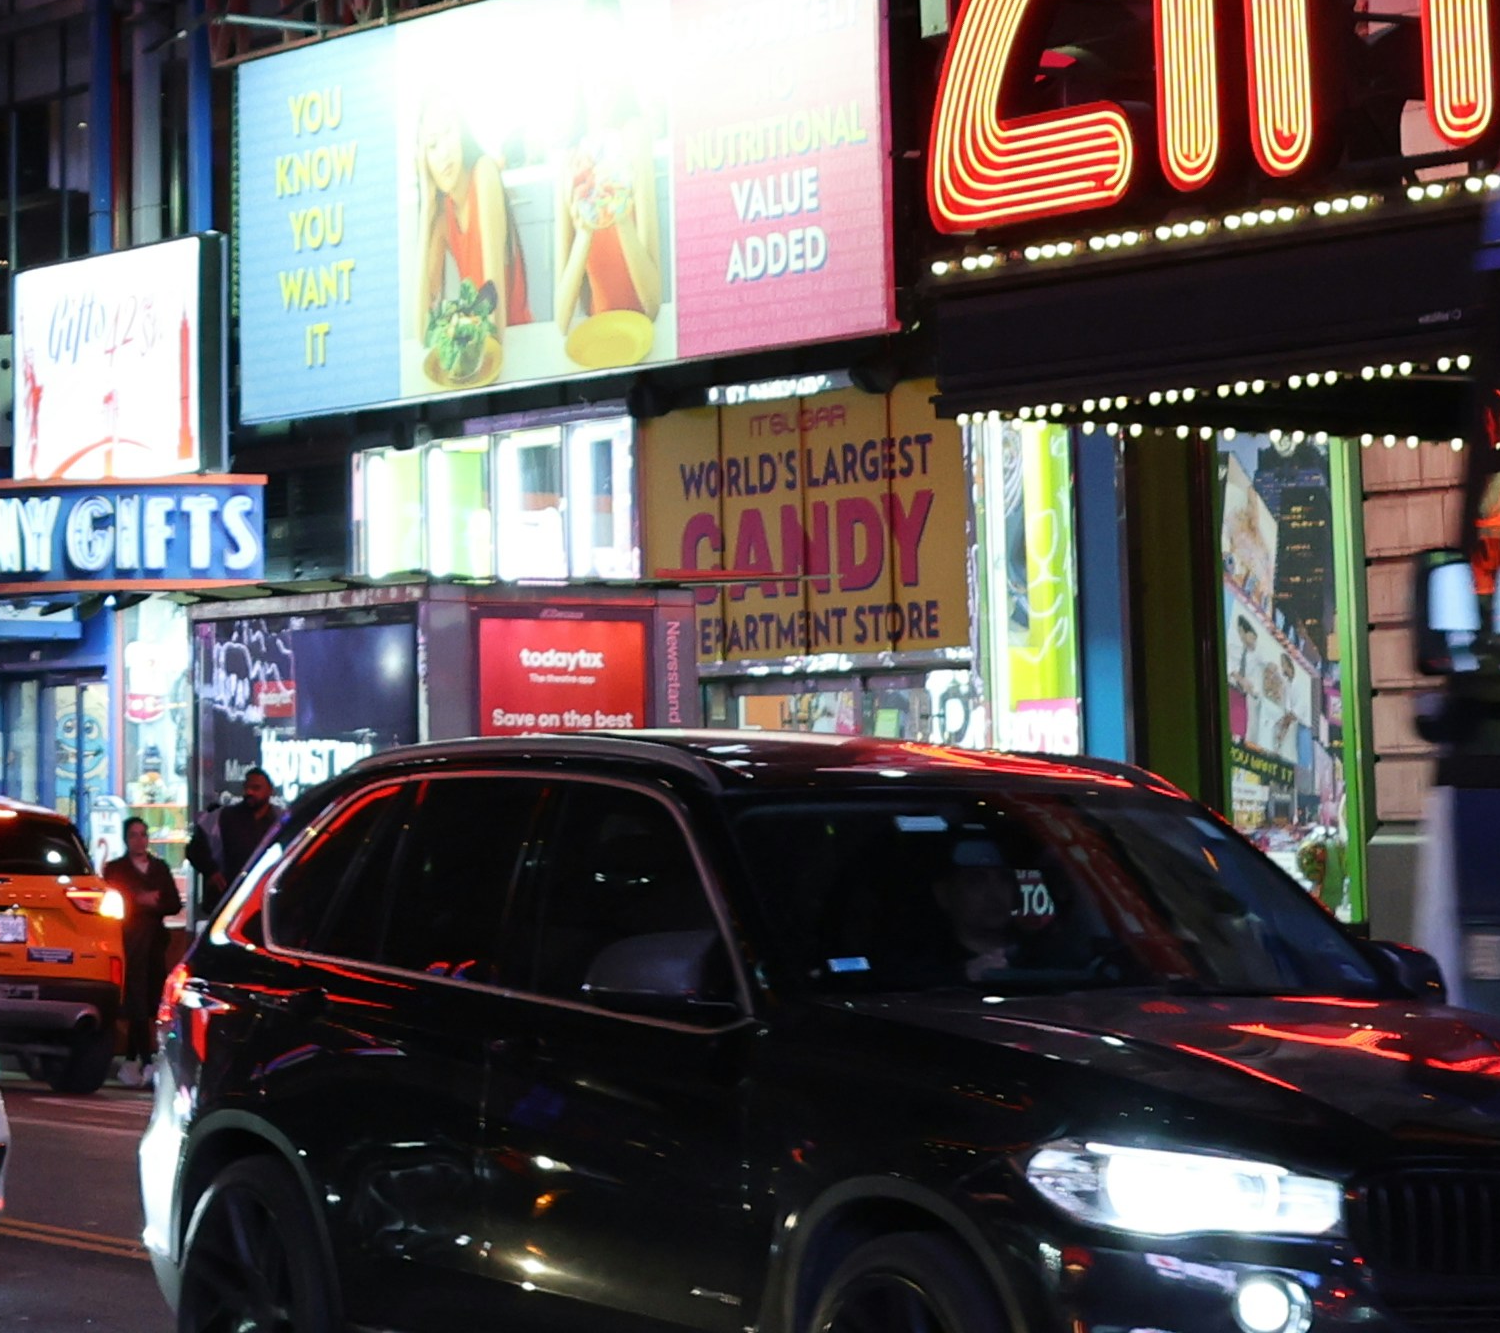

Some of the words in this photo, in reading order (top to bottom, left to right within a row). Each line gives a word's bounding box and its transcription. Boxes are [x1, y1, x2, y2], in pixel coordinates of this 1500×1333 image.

[287, 85, 343, 138] YOU
[680, 99, 868, 176] NUTRITIONAL
[274, 140, 357, 198] KNOW
[730, 167, 820, 223] VALUE
[288, 202, 345, 255] YOU
[726, 225, 827, 284] ADDED
[278, 259, 355, 314] WANT
[304, 323, 331, 369] IT
[680, 448, 799, 501] WORLD'S
[806, 434, 933, 487] LARGEST
[66, 492, 262, 573] GIFTS
[680, 488, 936, 606] CANDY
[701, 607, 848, 655] EPARTMENT
[854, 599, 940, 645] STORE
[519, 647, 605, 673] todaytix
[665, 621, 683, 725] Newsstand
[492, 708, 536, 727] Save
[537, 713, 561, 728] on
[563, 709, 593, 729] the
[594, 709, 634, 729] best
